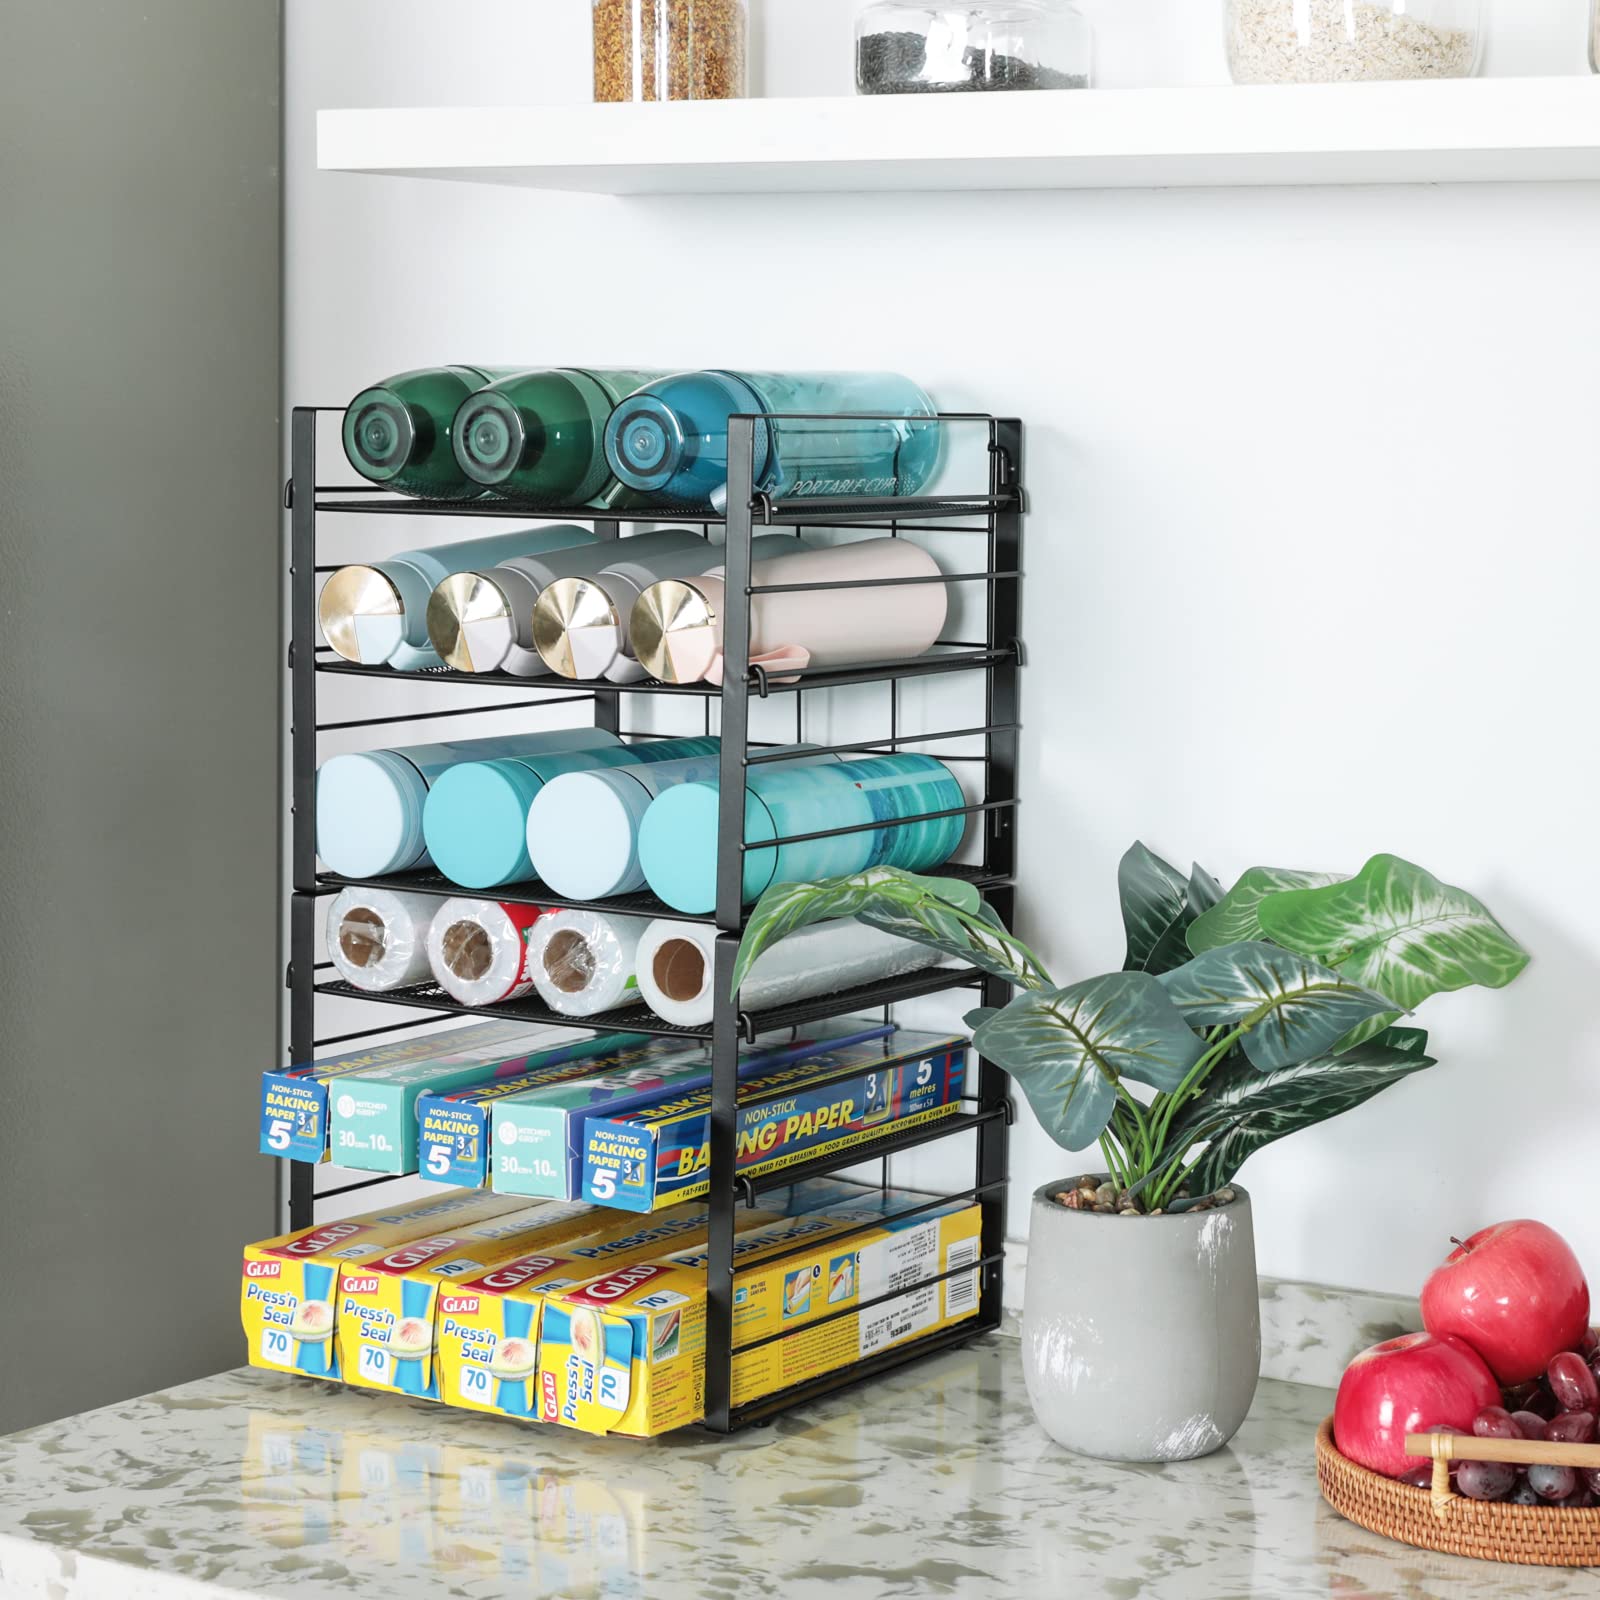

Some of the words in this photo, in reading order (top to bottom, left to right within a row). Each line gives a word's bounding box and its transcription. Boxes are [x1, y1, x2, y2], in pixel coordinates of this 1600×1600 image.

[787, 478, 866, 495] PORTABLE
[864, 477, 896, 492] CUP
[318, 1045, 432, 1073] BAKING
[474, 1066, 587, 1096] BAKING
[745, 1064, 820, 1088] PAPER
[916, 1057, 933, 1085] 5
[271, 1084, 313, 1098] NON-STICK
[866, 1073, 877, 1099] 3
[909, 1084, 936, 1100] metres
[266, 1092, 320, 1113] BAKING
[744, 1099, 797, 1125] NON-STICK
[265, 1107, 296, 1121] PAPER
[298, 1112, 306, 1126] 3
[429, 1108, 473, 1121] NON-STICK
[783, 1099, 854, 1144] PAPER
[267, 1119, 292, 1150] 5
[424, 1117, 480, 1136] BAKING
[423, 1131, 455, 1145] PAPER
[457, 1136, 465, 1150] 3
[595, 1130, 640, 1145] NON-STICK
[747, 1167, 757, 1176] NO
[759, 1162, 774, 1172] NEED
[775, 1158, 788, 1167] FOR
[789, 1149, 817, 1163] GREASING
[823, 1141, 840, 1151] FOOD
[841, 1135, 860, 1146] GRADE
[861, 1128, 884, 1140] QUALITY
[891, 1114, 922, 1129] MICROWAVE
[928, 1110, 943, 1118] OVEN
[944, 1104, 959, 1113] SAFE
[426, 1144, 452, 1176] 5
[588, 1139, 647, 1160] BAKING
[588, 1153, 621, 1169] PAPER
[623, 1160, 632, 1174] 3
[590, 1167, 617, 1199] 5
[287, 1223, 360, 1254] GLAD
[766, 1220, 833, 1239] Seal
[339, 1249, 365, 1258] 70
[383, 1237, 457, 1268] GLAD
[246, 1262, 280, 1276] GLAD
[435, 1264, 463, 1275] 70
[483, 1257, 556, 1287] GLAD
[343, 1278, 377, 1292] GLAD
[535, 1283, 563, 1292] 70
[585, 1265, 658, 1298] GLAD
[247, 1283, 297, 1308] Press'n
[443, 1297, 478, 1312] GLAD
[639, 1297, 669, 1307] 70
[263, 1305, 295, 1325] Seal
[344, 1299, 395, 1325] Press'n
[268, 1331, 287, 1352] 70
[360, 1322, 392, 1343] Seal
[444, 1319, 497, 1345] Press'n
[366, 1348, 385, 1369] 70
[461, 1342, 494, 1363] Seal
[467, 1369, 487, 1390] 70
[563, 1354, 579, 1421] Press'n
[580, 1360, 594, 1403] Seal
[601, 1374, 617, 1400] 70
[543, 1371, 558, 1418] GLAD
